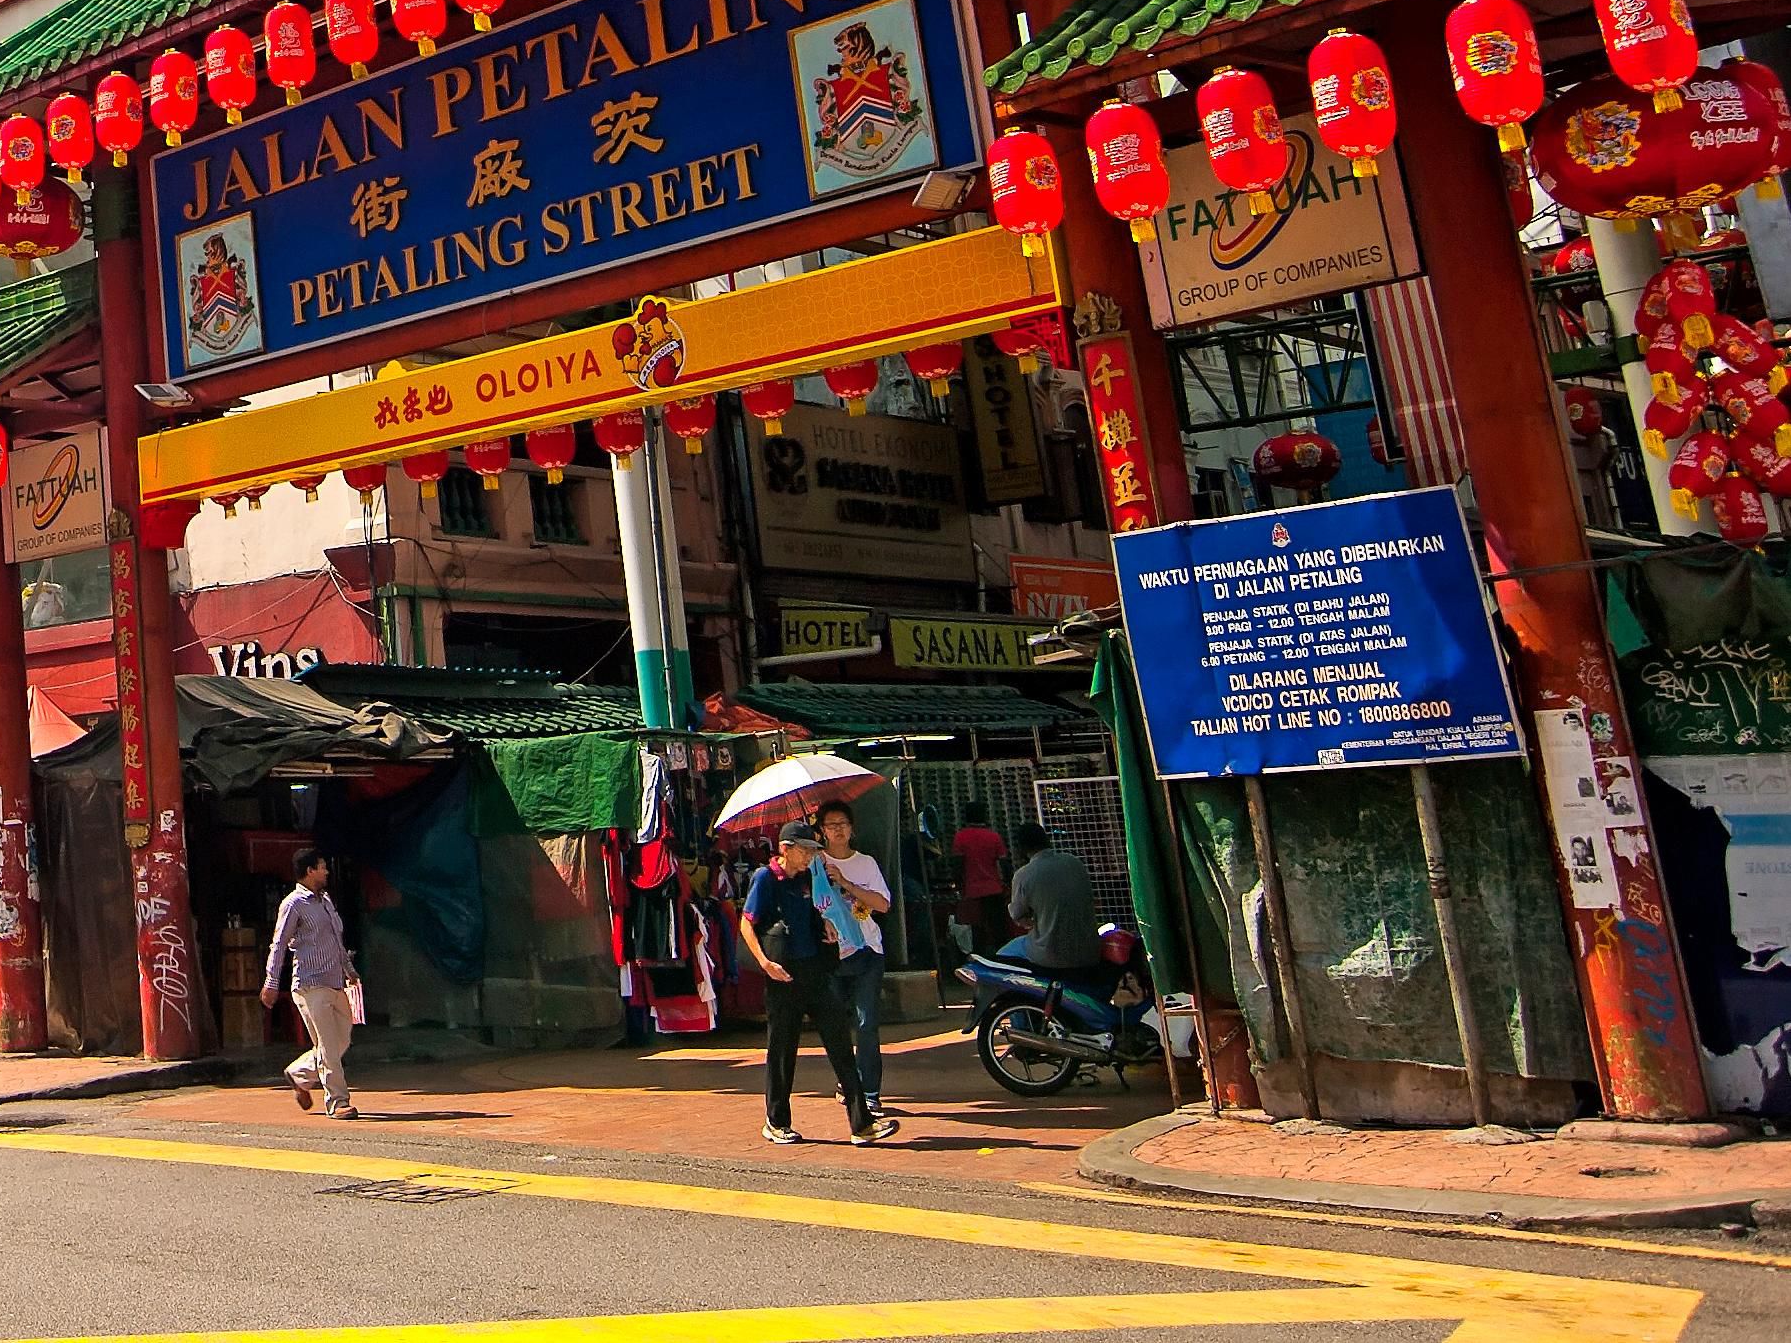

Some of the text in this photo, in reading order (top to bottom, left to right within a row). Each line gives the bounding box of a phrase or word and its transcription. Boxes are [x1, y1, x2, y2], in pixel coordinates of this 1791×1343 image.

[183, 86, 407, 220] JALAN
[1167, 165, 1363, 241] FATUAH
[289, 143, 760, 325] PETALING STREET
[1178, 245, 1383, 307] GROUP OF COMPANIES
[476, 349, 603, 403] OLOIYA
[17, 522, 103, 552] GROUP OF COMPANIES
[1139, 535, 1445, 590] WAKTU PERNIAGAAN YANG DIBENARKAN
[1214, 566, 1363, 600] DI JALAN PETALING
[1203, 592, 1390, 624] PENJAJA STATIK (DI BAHU JALAN)
[1229, 619, 1252, 634] PAGI
[1268, 616, 1295, 630] 12.00
[1298, 611, 1344, 627] TENGAH
[1348, 606, 1390, 622] MALAM
[785, 620, 870, 647] HOTEL
[912, 624, 1009, 666] SASANA
[1208, 624, 1392, 655] PENJAJA STATIK (DI ATAS JALAN)
[1223, 650, 1266, 666] PETANG
[1282, 646, 1309, 661] 12.00
[1313, 641, 1360, 658] TENGAH
[1364, 636, 1407, 653] MALAM
[1229, 661, 1386, 692] DILARANG MENJUAL
[1222, 681, 1402, 714] VCD/CD CETAK ROMPAK
[1191, 716, 1239, 737] TALIAN
[1243, 713, 1272, 733] HOT
[1278, 710, 1313, 730] LINE
[1318, 710, 1342, 727] NO
[1358, 701, 1451, 724] 1800886800
[1447, 725, 1471, 734] KUALA
